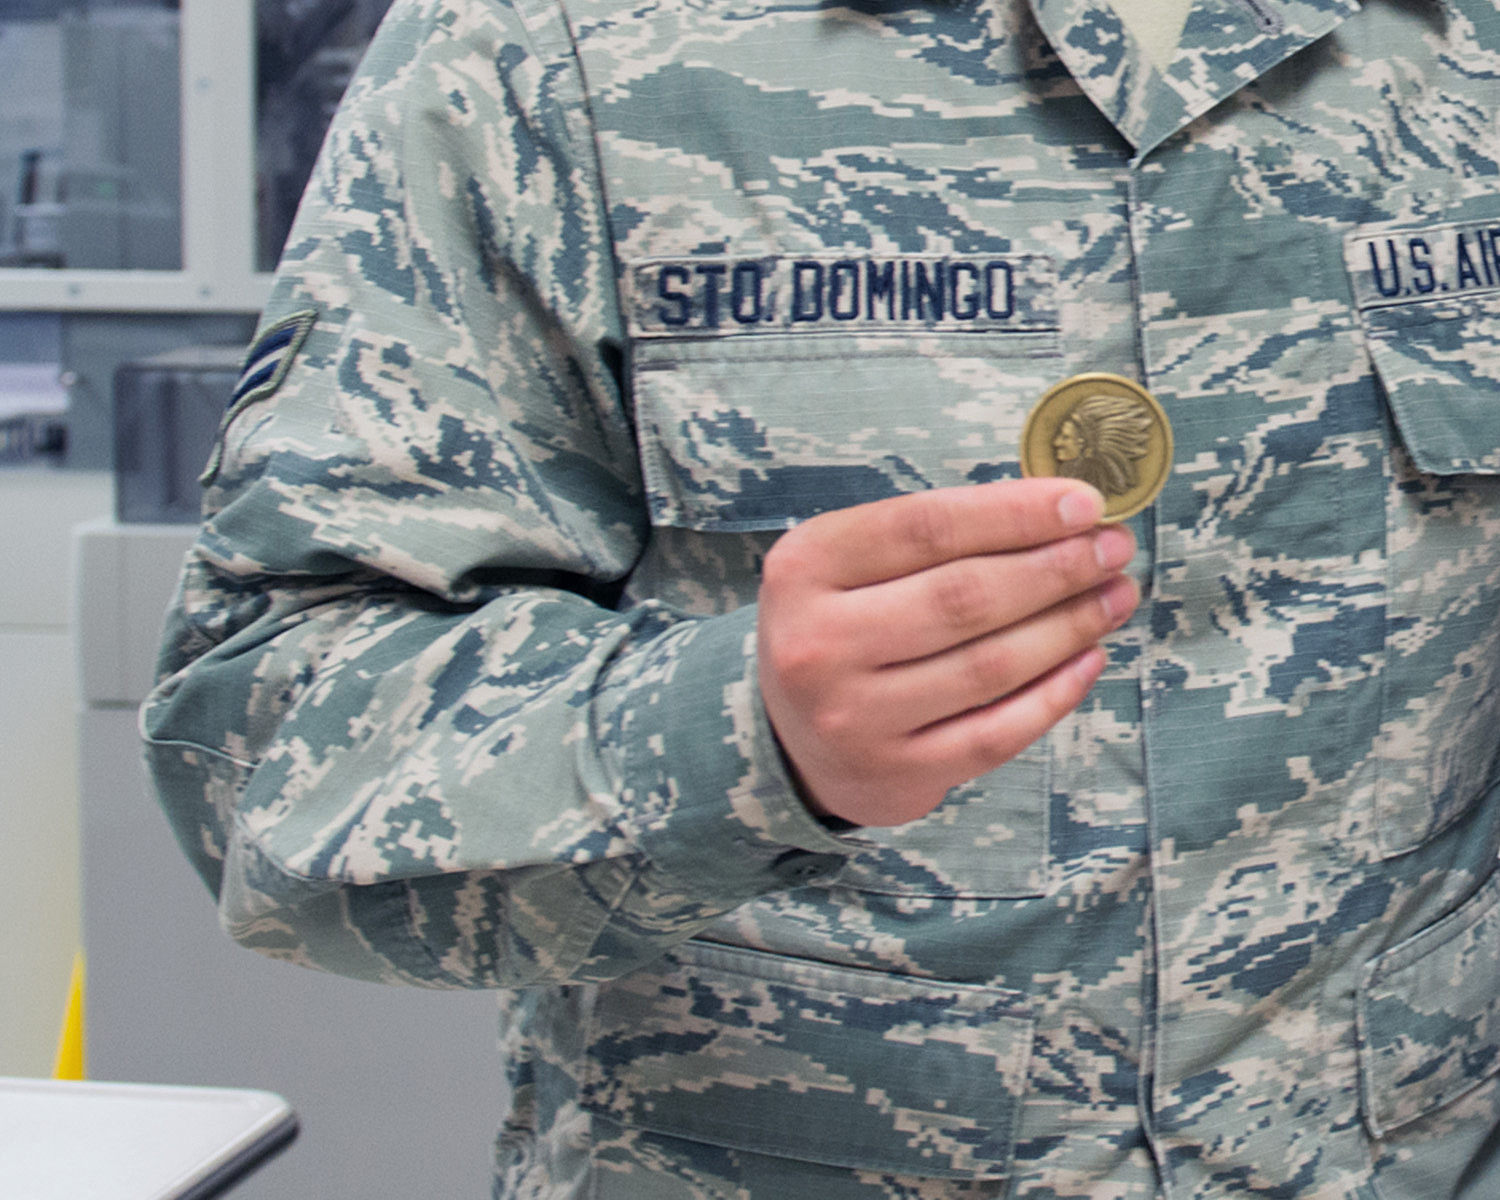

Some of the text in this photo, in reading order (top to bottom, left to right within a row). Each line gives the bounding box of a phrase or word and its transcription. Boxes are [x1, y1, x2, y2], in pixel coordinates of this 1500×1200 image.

[656, 259, 1015, 327] STO. DOMINGO
[1367, 237, 1449, 298] U.S.
